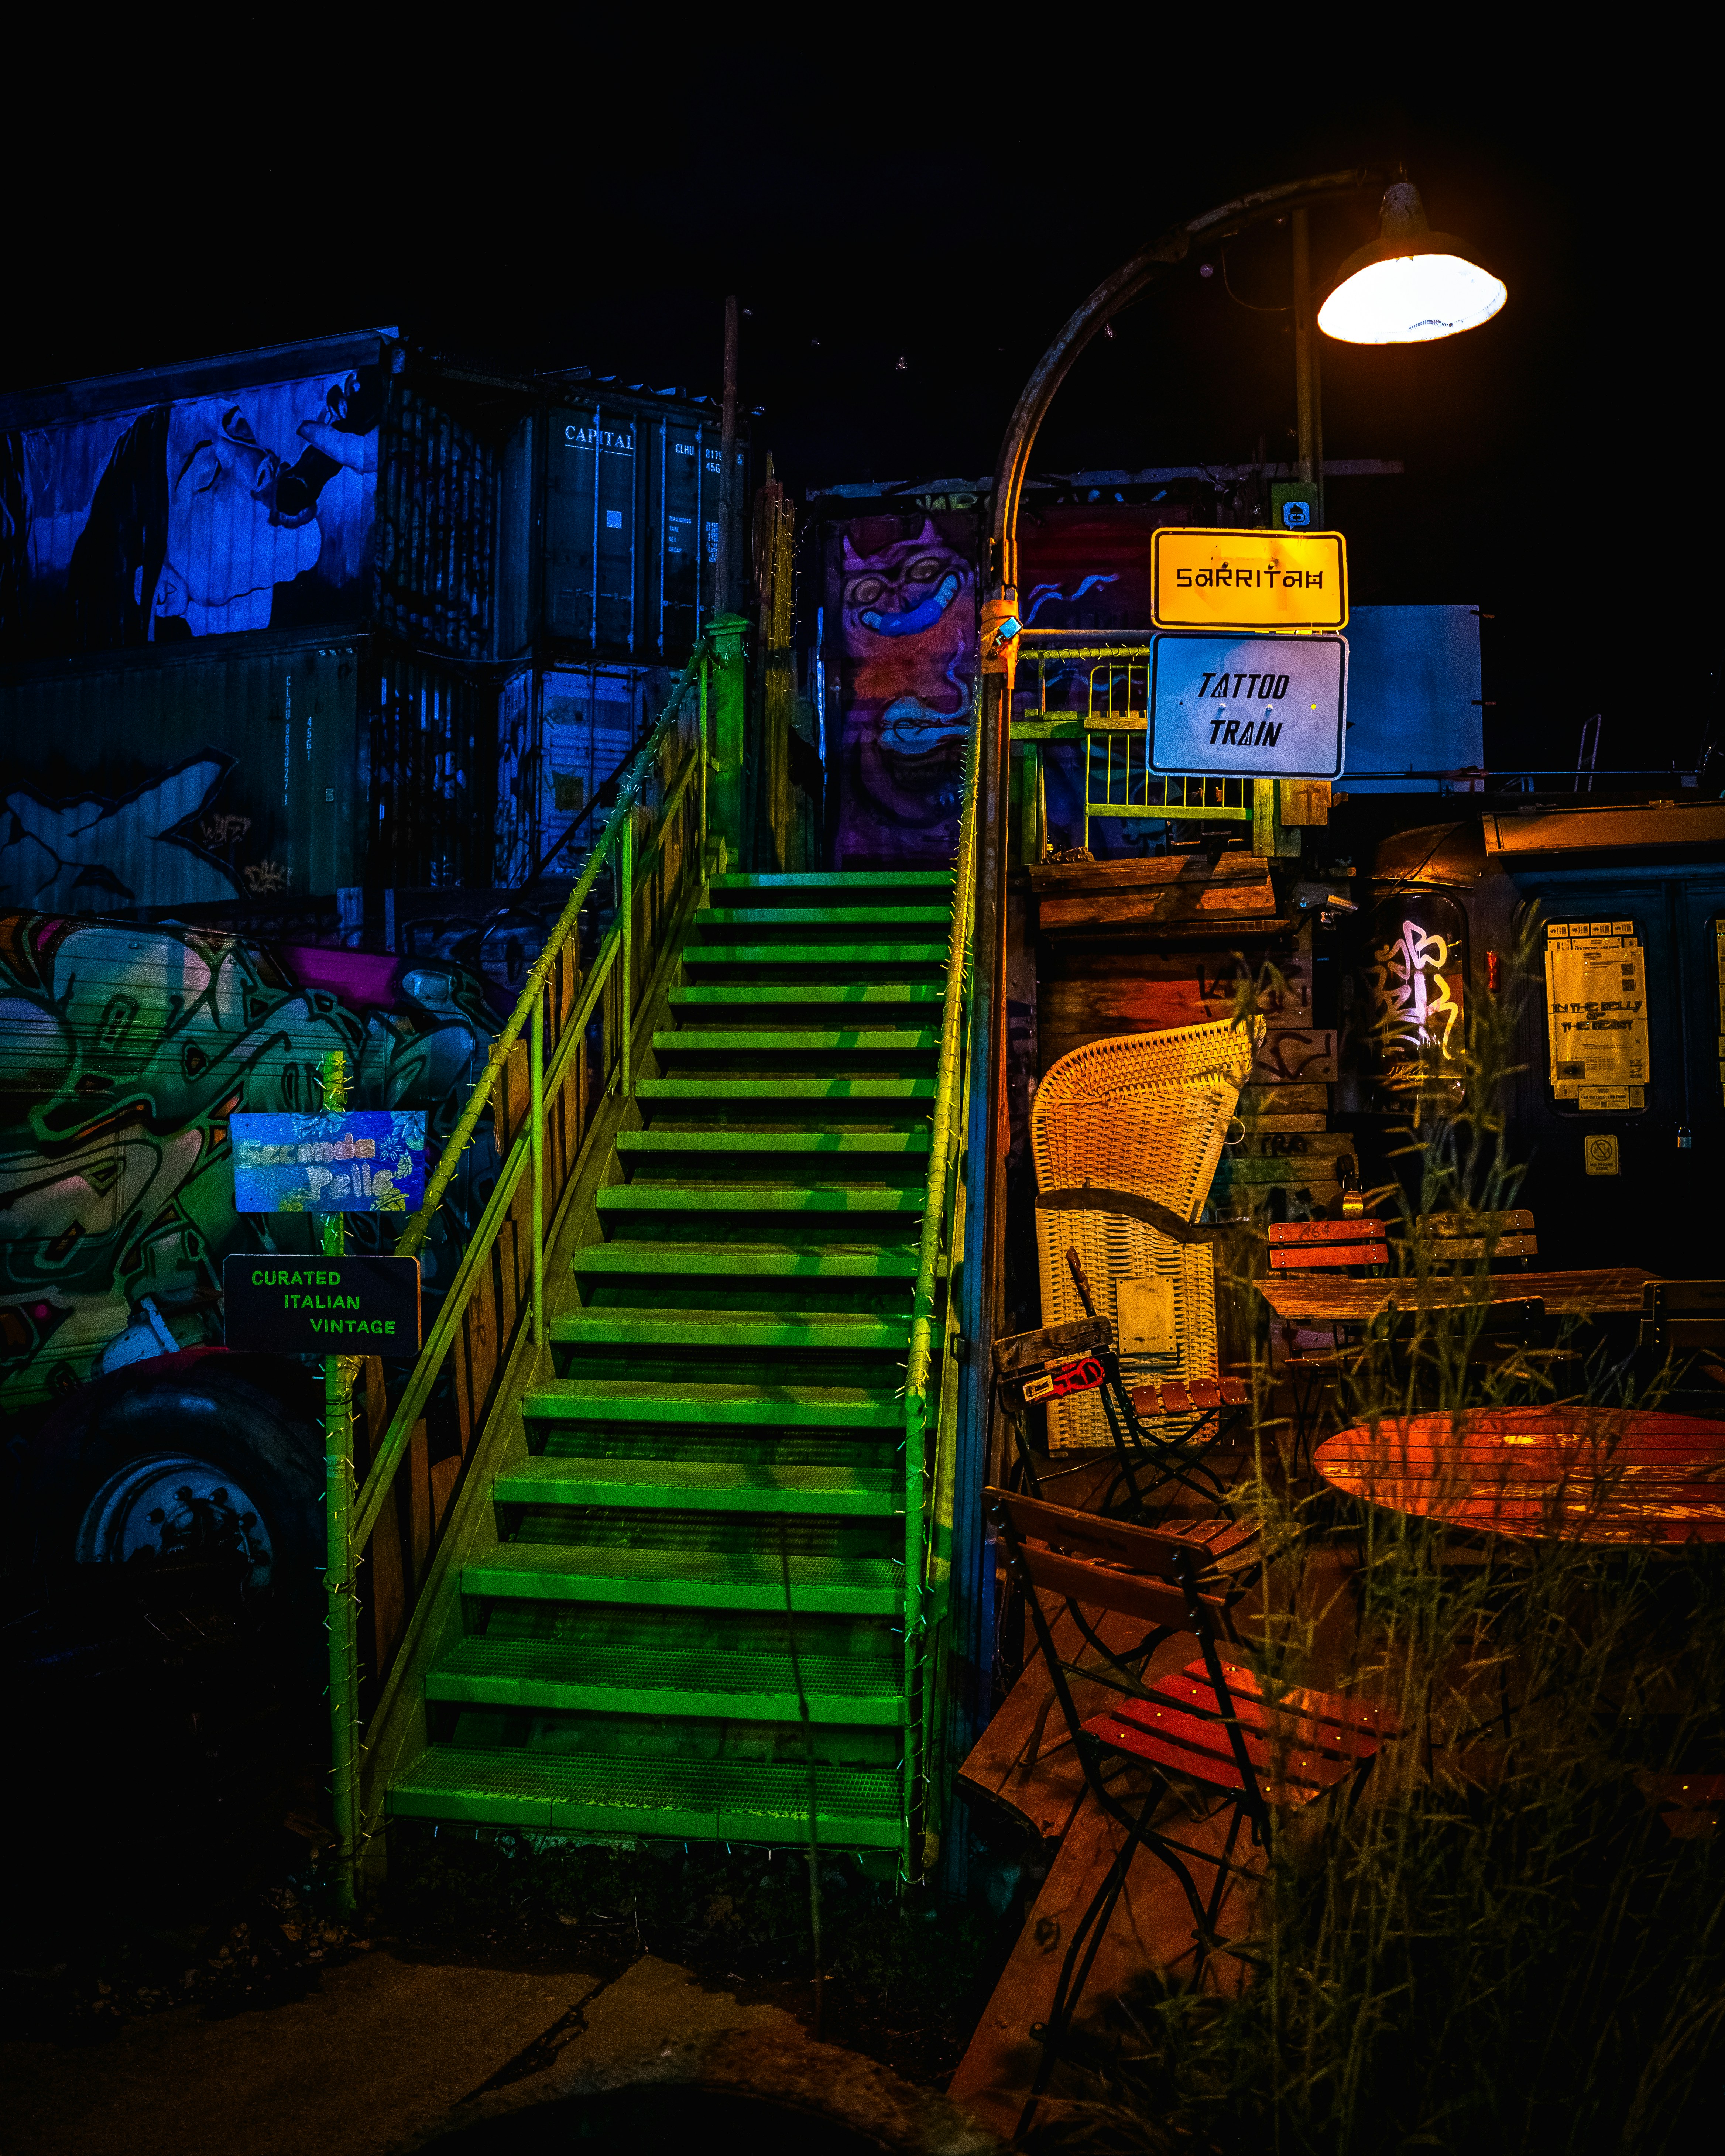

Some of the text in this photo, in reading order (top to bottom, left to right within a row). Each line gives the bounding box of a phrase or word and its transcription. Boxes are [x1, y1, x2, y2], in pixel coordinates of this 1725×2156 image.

[565, 425, 634, 449] CAPITAL
[675, 444, 695, 456] CLHU
[1198, 673, 1290, 699] TATTOO
[1210, 720, 1283, 747] TRAIN
[1551, 1003, 1568, 1013] IN
[1570, 1002, 1599, 1013] THE
[1586, 1012, 1606, 1020] OF
[1561, 1019, 1634, 1033] THE BEAST
[239, 1132, 376, 1167] Seconda
[306, 1163, 394, 1201] Pelle
[252, 1270, 341, 1286] CURATED
[284, 1294, 360, 1310] ITALIAN
[310, 1319, 395, 1335] VINTAGE
